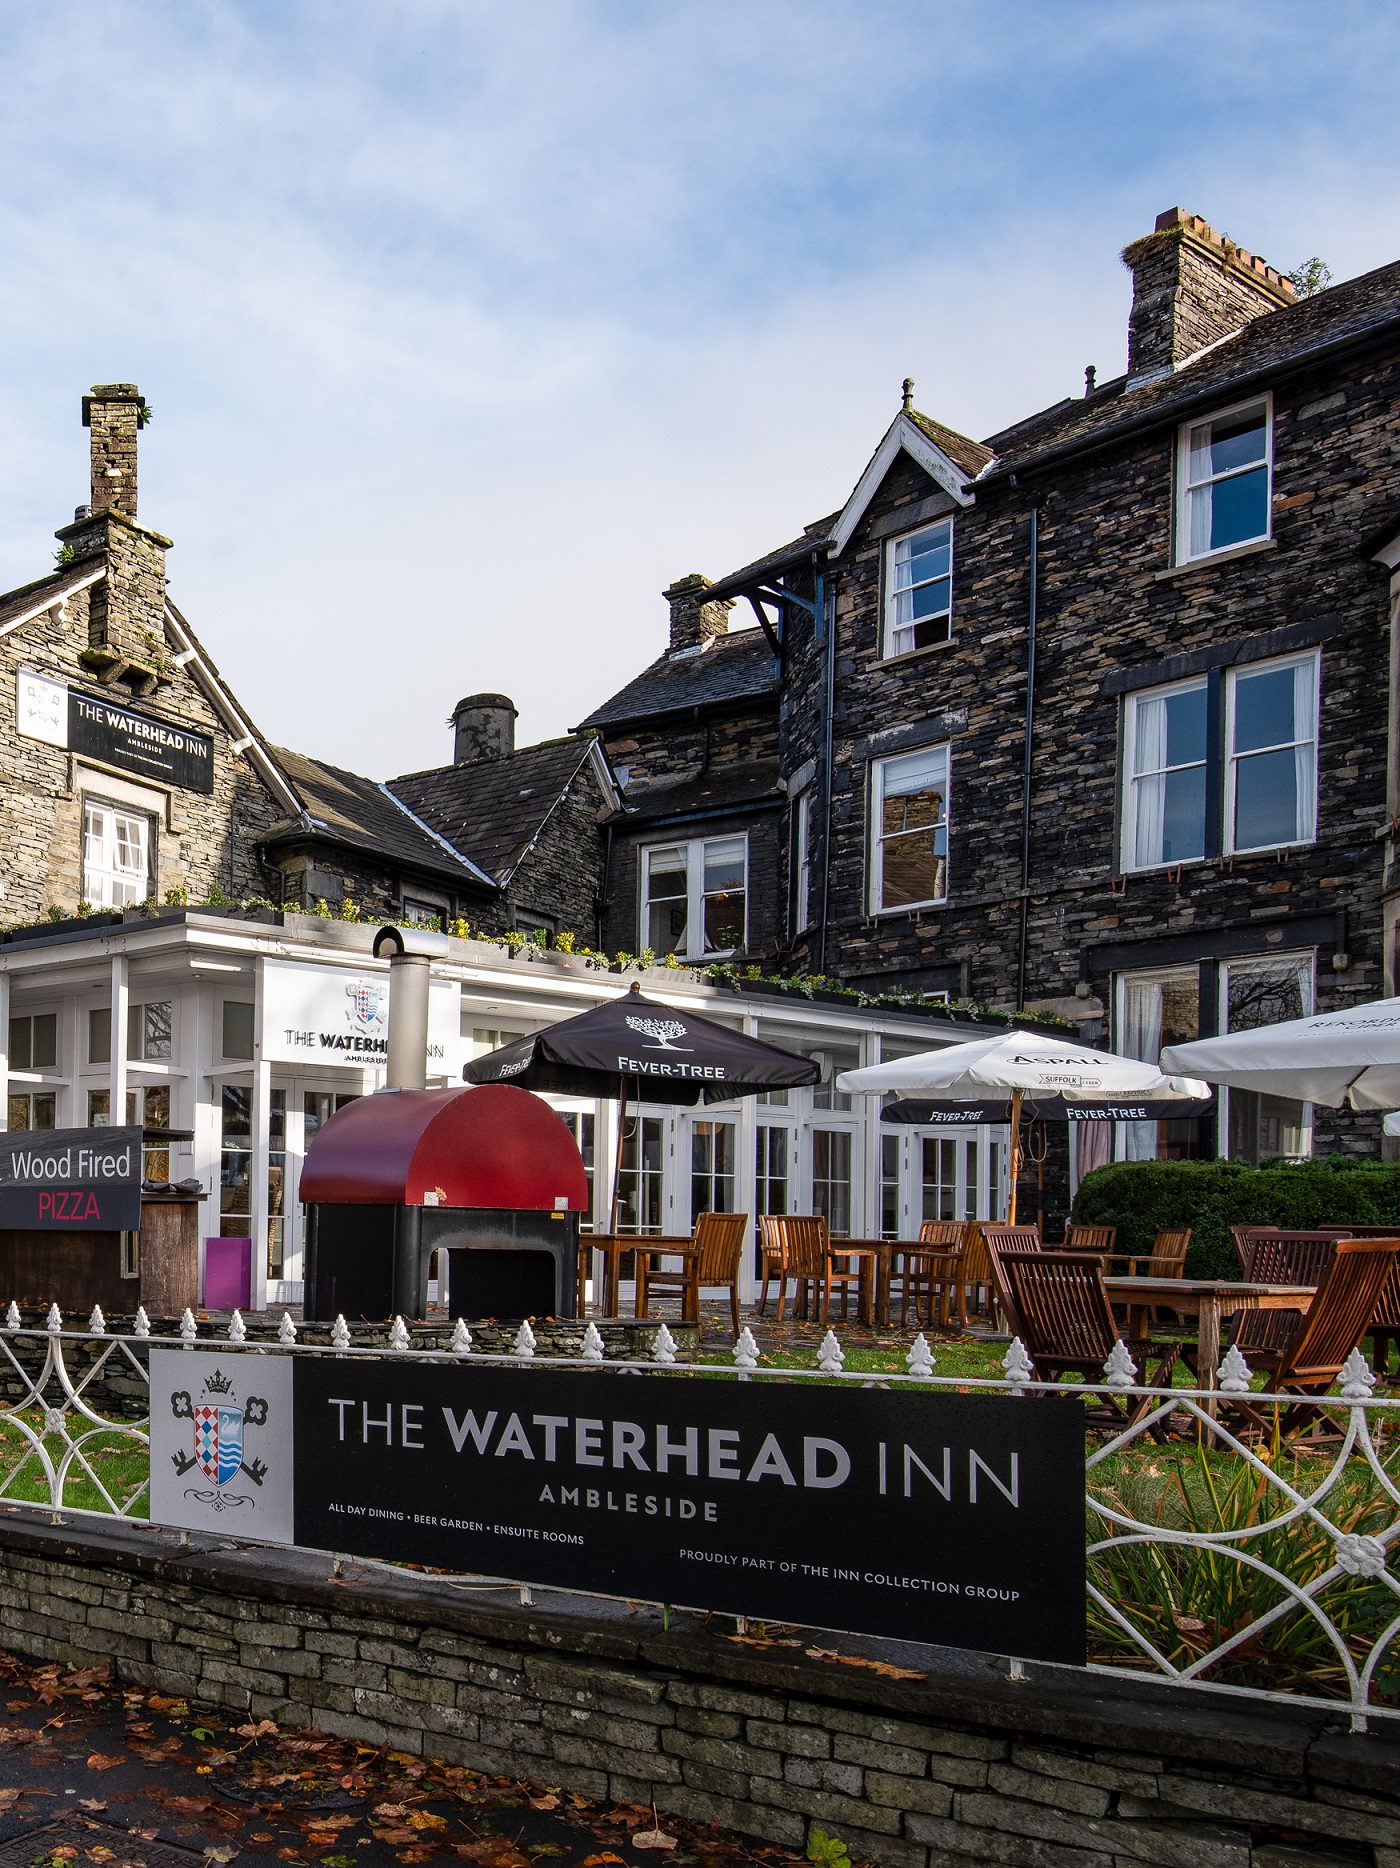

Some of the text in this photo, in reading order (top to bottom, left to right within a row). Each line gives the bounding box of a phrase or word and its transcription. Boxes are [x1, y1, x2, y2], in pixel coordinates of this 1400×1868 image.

[77, 701, 207, 758] THE WATERHEAD INN
[127, 737, 163, 755] AMBLESIDE
[284, 1029, 315, 1047] THE
[618, 1056, 725, 1079] FEVER-TREE
[1013, 1055, 1109, 1065] ASPALL
[1045, 1075, 1077, 1083] SUFFOLK
[929, 1110, 983, 1122] FEVER-TREE
[1066, 1107, 1147, 1119] FEVER-TREE
[11, 1146, 130, 1179] Wood Fired
[39, 1192, 101, 1220] PIZZA
[328, 1398, 1019, 1508] THE WATERHEAD INN
[539, 1484, 718, 1522] AMBLESIDE
[328, 1503, 584, 1545] ALL DAY DINING BEER GARDEN ENSUITE ROOMS
[679, 1549, 1020, 1602] PROUDLY PART OF THE INN COLLECTION GROUP
